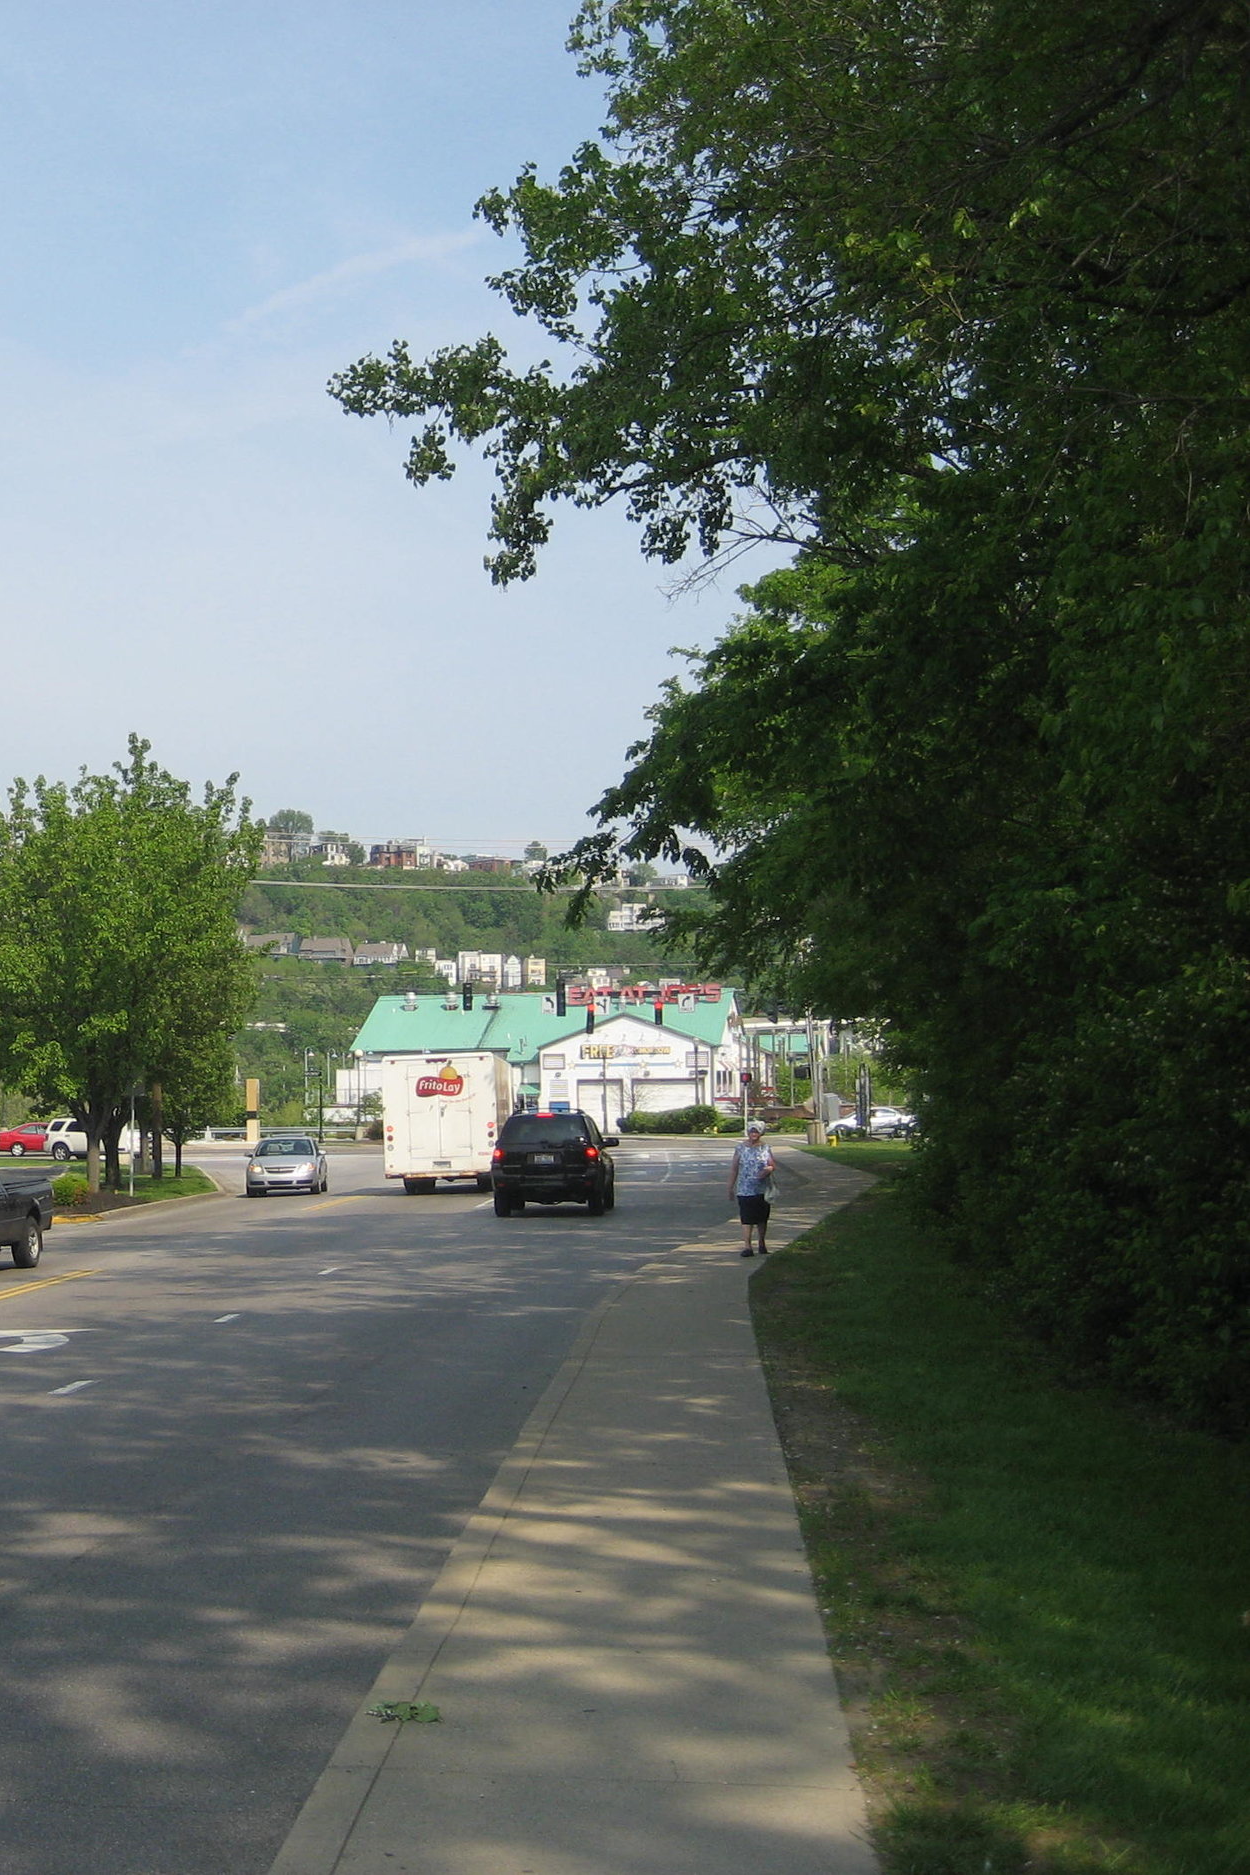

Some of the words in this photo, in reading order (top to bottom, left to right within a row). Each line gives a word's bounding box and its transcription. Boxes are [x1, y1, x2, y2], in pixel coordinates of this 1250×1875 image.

[567, 986, 613, 1005] EAT
[618, 985, 647, 1004] AT
[580, 1044, 615, 1059] FREE
